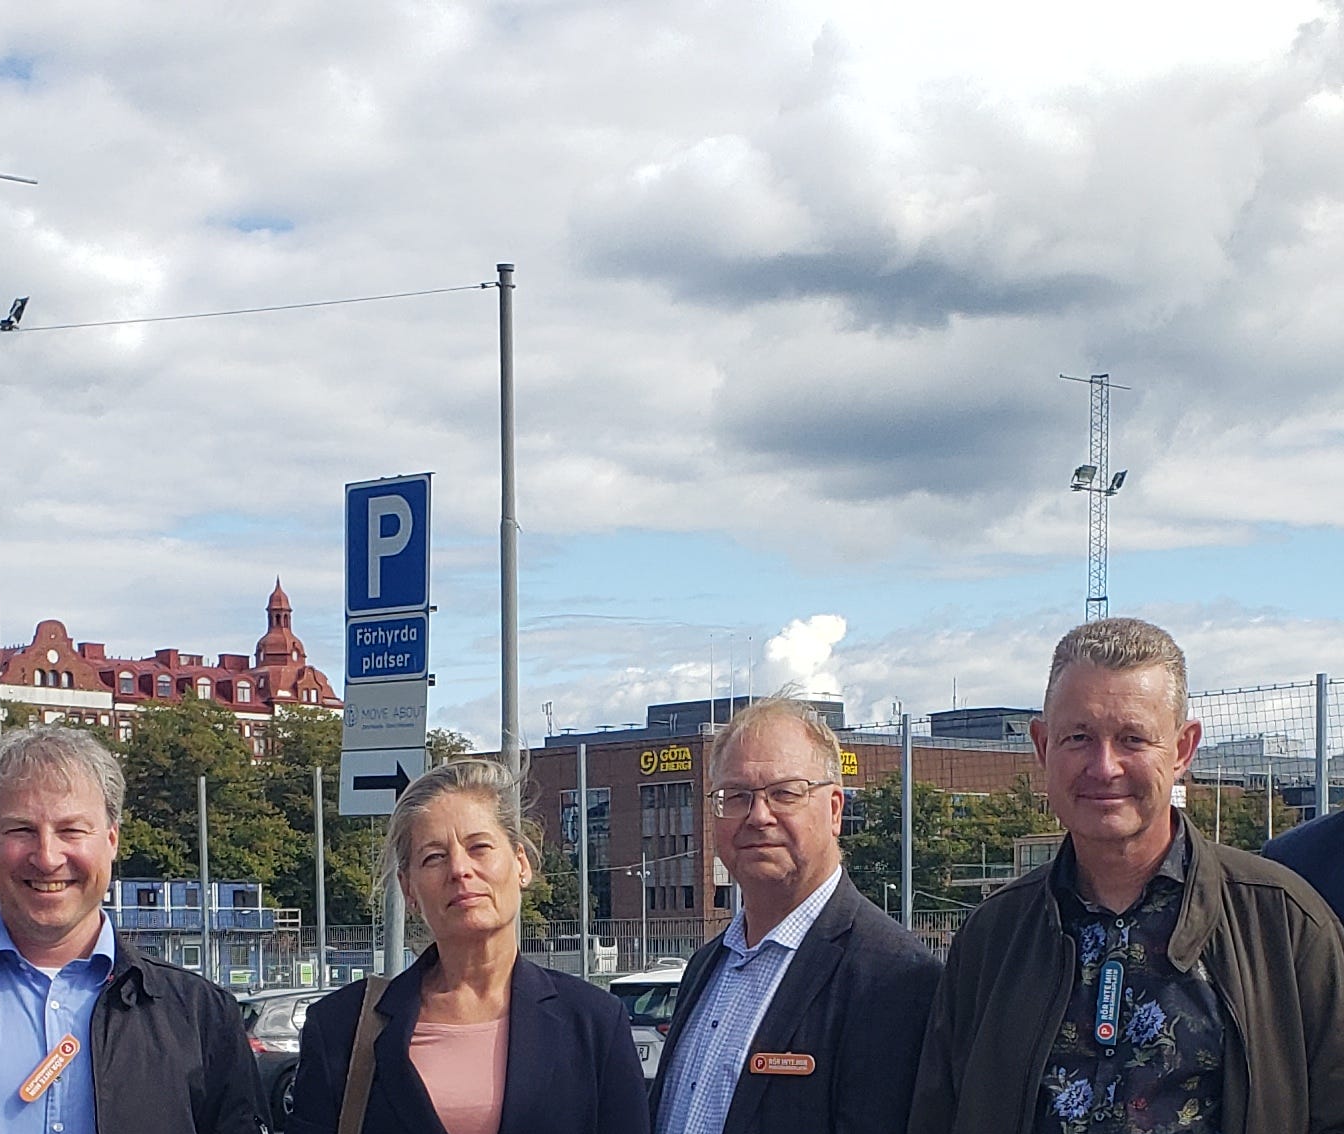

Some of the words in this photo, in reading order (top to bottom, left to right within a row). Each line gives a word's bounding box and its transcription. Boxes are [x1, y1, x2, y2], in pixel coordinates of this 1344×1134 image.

[368, 494, 414, 599] P
[356, 626, 417, 650] Förhyrda
[362, 652, 411, 674] platser
[362, 707, 389, 721] MOVE
[393, 705, 425, 721] ABOUT
[660, 745, 691, 762] GÖTA
[1104, 968, 1113, 984] MIN
[1103, 984, 1111, 1003] INTE
[1100, 1004, 1109, 1020] RÖR
